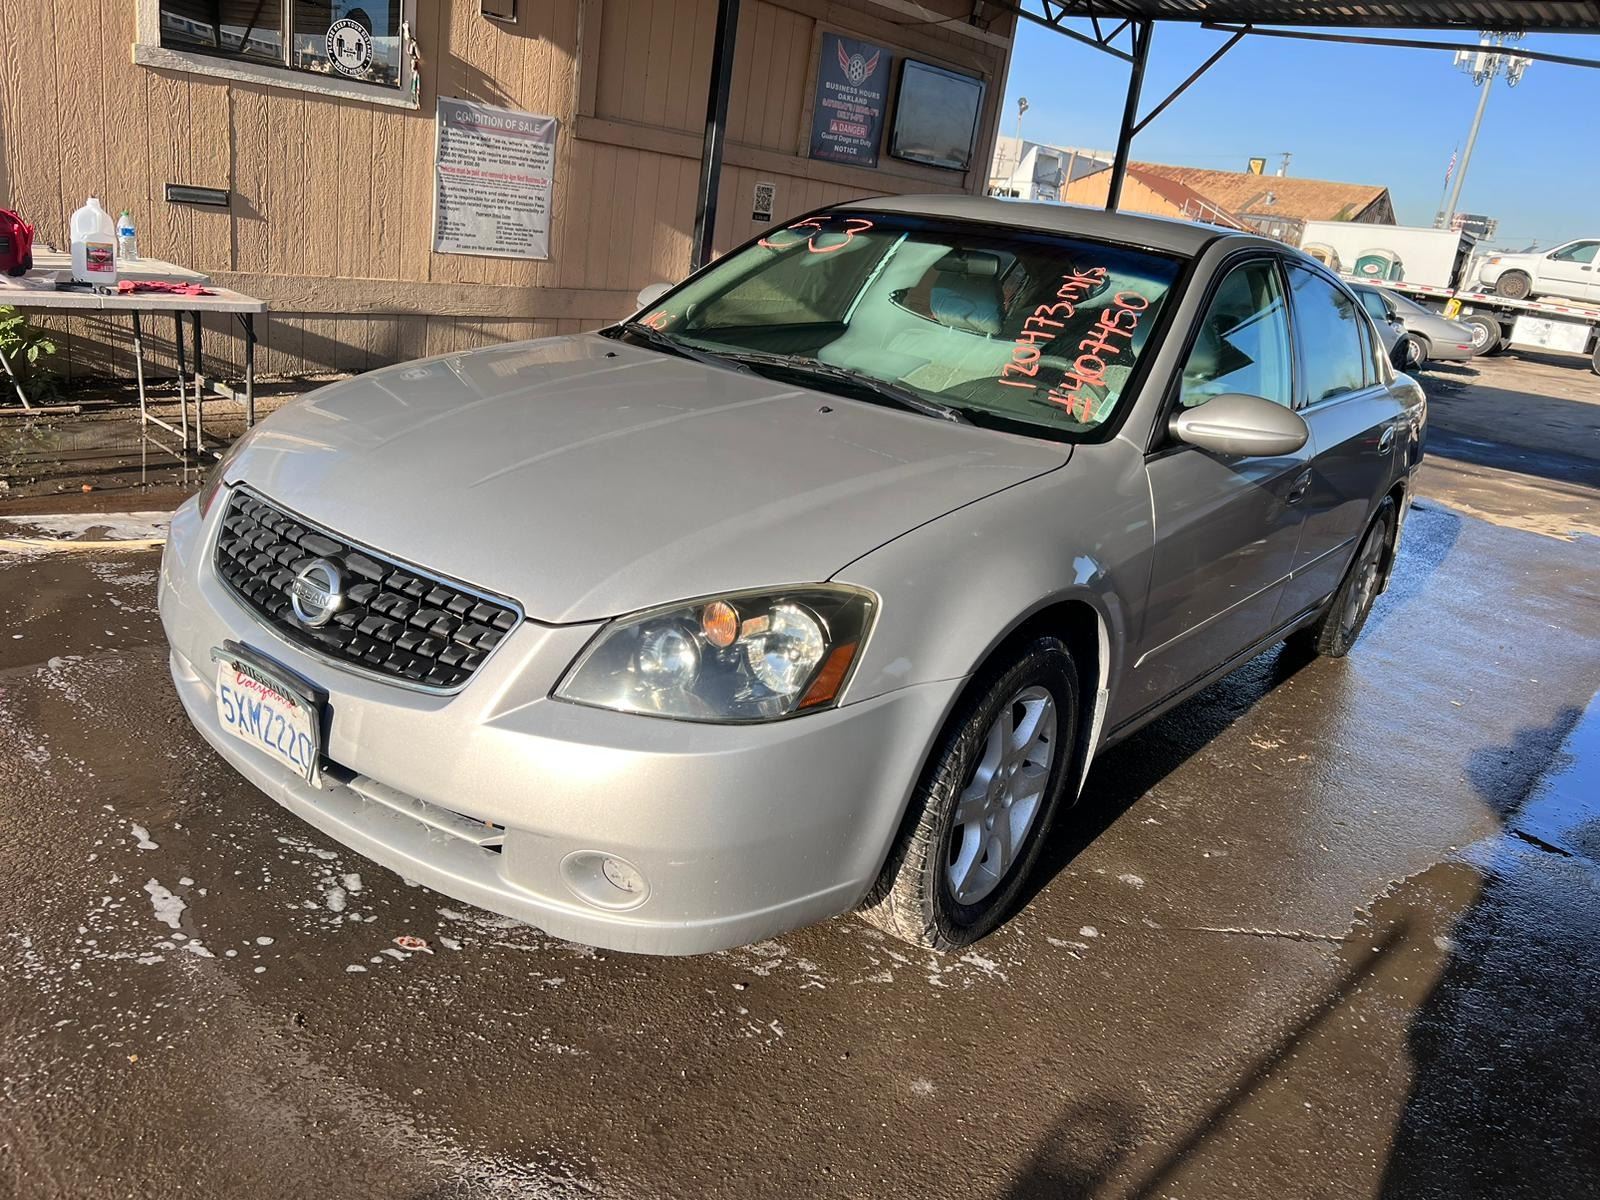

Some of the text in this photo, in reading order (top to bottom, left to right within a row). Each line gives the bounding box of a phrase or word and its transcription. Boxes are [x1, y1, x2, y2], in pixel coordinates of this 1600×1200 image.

[328, 30, 336, 54] PLEASE
[334, 22, 346, 31] KEEP
[348, 22, 362, 32] YOUR
[361, 32, 372, 60] DISTANCE
[335, 60, 364, 76] WAIT HERE
[826, 81, 880, 100] BUSINESS HOURS
[838, 93, 868, 104] OAKLAND
[455, 110, 540, 133] CONDITION OF SALE
[840, 123, 865, 136] DANGER
[449, 130, 469, 138] vehicles
[821, 132, 838, 141] Guard
[838, 135, 852, 144] Dogs
[860, 139, 872, 148] Duty
[440, 136, 468, 145] guarantees
[476, 141, 500, 150] warranties
[501, 145, 525, 154] expressed
[834, 145, 857, 154] NOTICE
[508, 154, 528, 162] immediate
[221, 684, 312, 769] 5XMZ220
